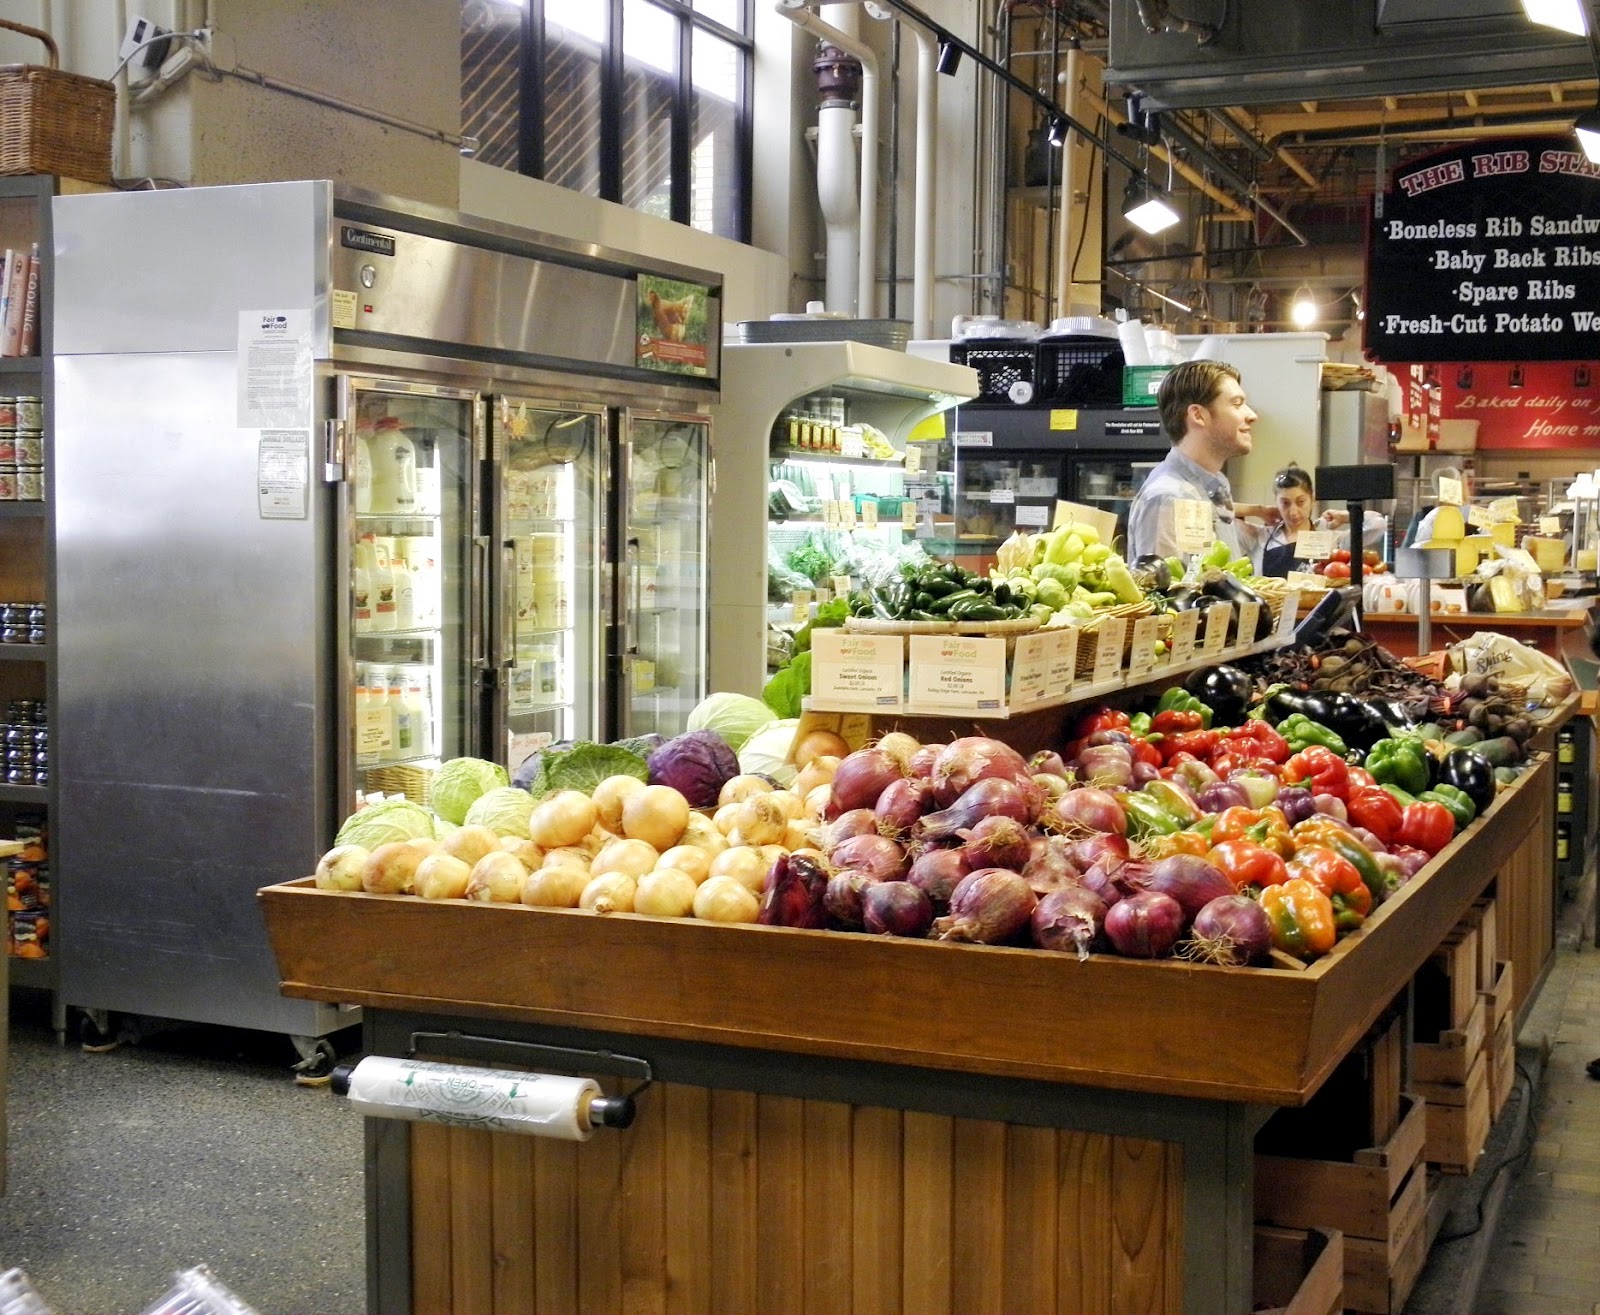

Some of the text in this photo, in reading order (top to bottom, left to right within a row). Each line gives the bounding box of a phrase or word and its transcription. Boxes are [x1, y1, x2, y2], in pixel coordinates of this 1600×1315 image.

[1400, 150, 1600, 197] THE RIB STA
[1388, 219, 1477, 240] Boneless
[1485, 216, 1523, 237] Rib
[347, 228, 392, 250] Continental
[1434, 246, 1600, 274] Baby Back Ribs
[24, 272, 38, 332] COOKING
[1459, 280, 1576, 306] Spare Ribs
[1385, 314, 1487, 334] Fresh-Cut
[1495, 312, 1563, 333] Potato
[1455, 395, 1591, 415] Baked daily on
[1523, 418, 1578, 438] Home
[842, 639, 859, 647] Fair
[852, 647, 876, 656] Food
[943, 641, 960, 649] Fair
[954, 649, 977, 658] Food
[445, 1076, 480, 1091] OPEN
